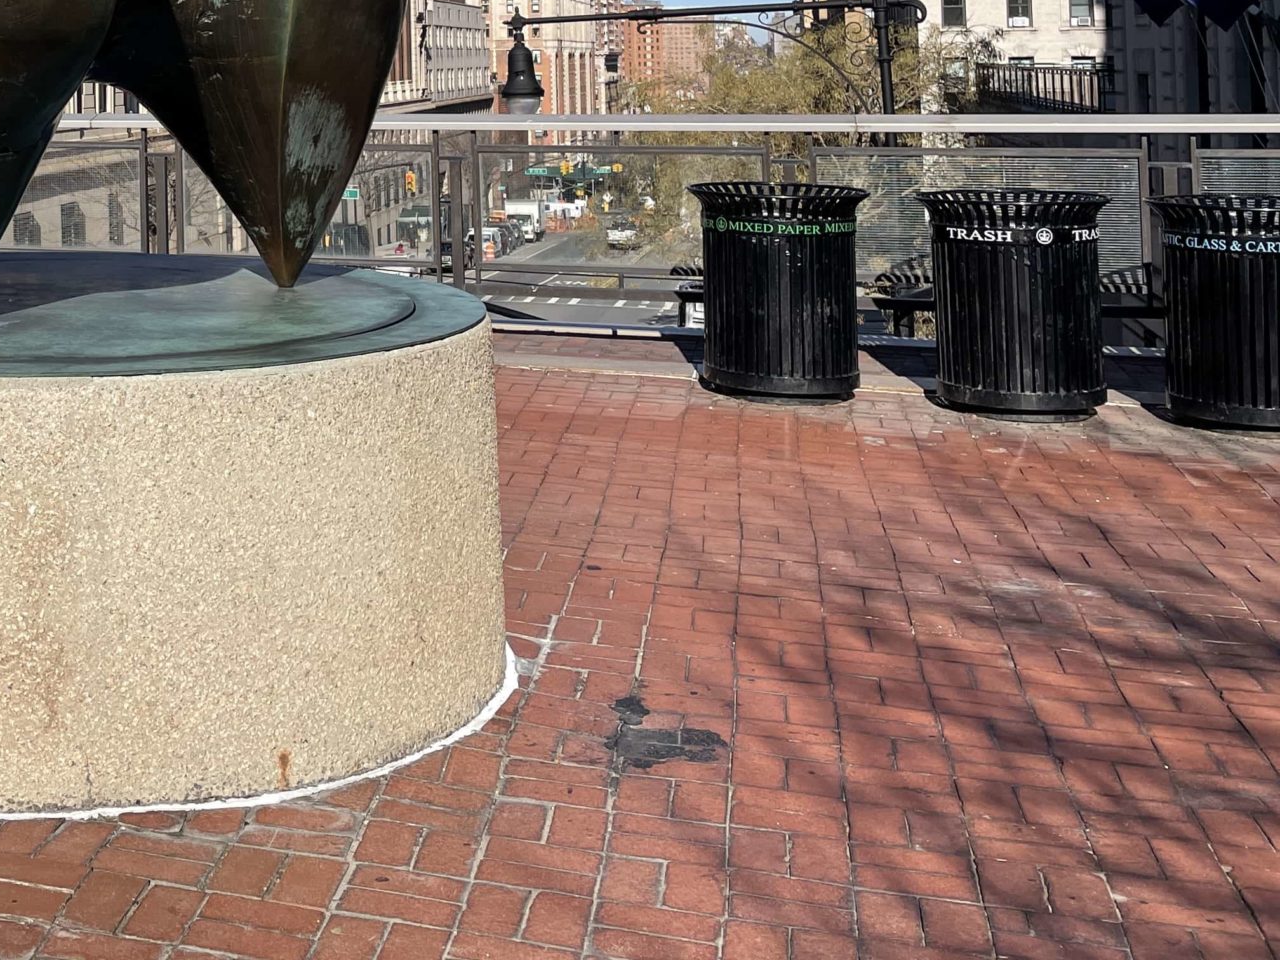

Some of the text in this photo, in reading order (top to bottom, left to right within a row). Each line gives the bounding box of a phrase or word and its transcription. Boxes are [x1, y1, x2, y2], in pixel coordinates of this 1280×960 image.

[729, 221, 773, 234] MIXED
[777, 225, 821, 235] PAPER
[824, 222, 854, 233] MIXED
[946, 227, 1013, 242] TRASH
[1185, 236, 1227, 251] GLASS
[1229, 239, 1242, 252] &
